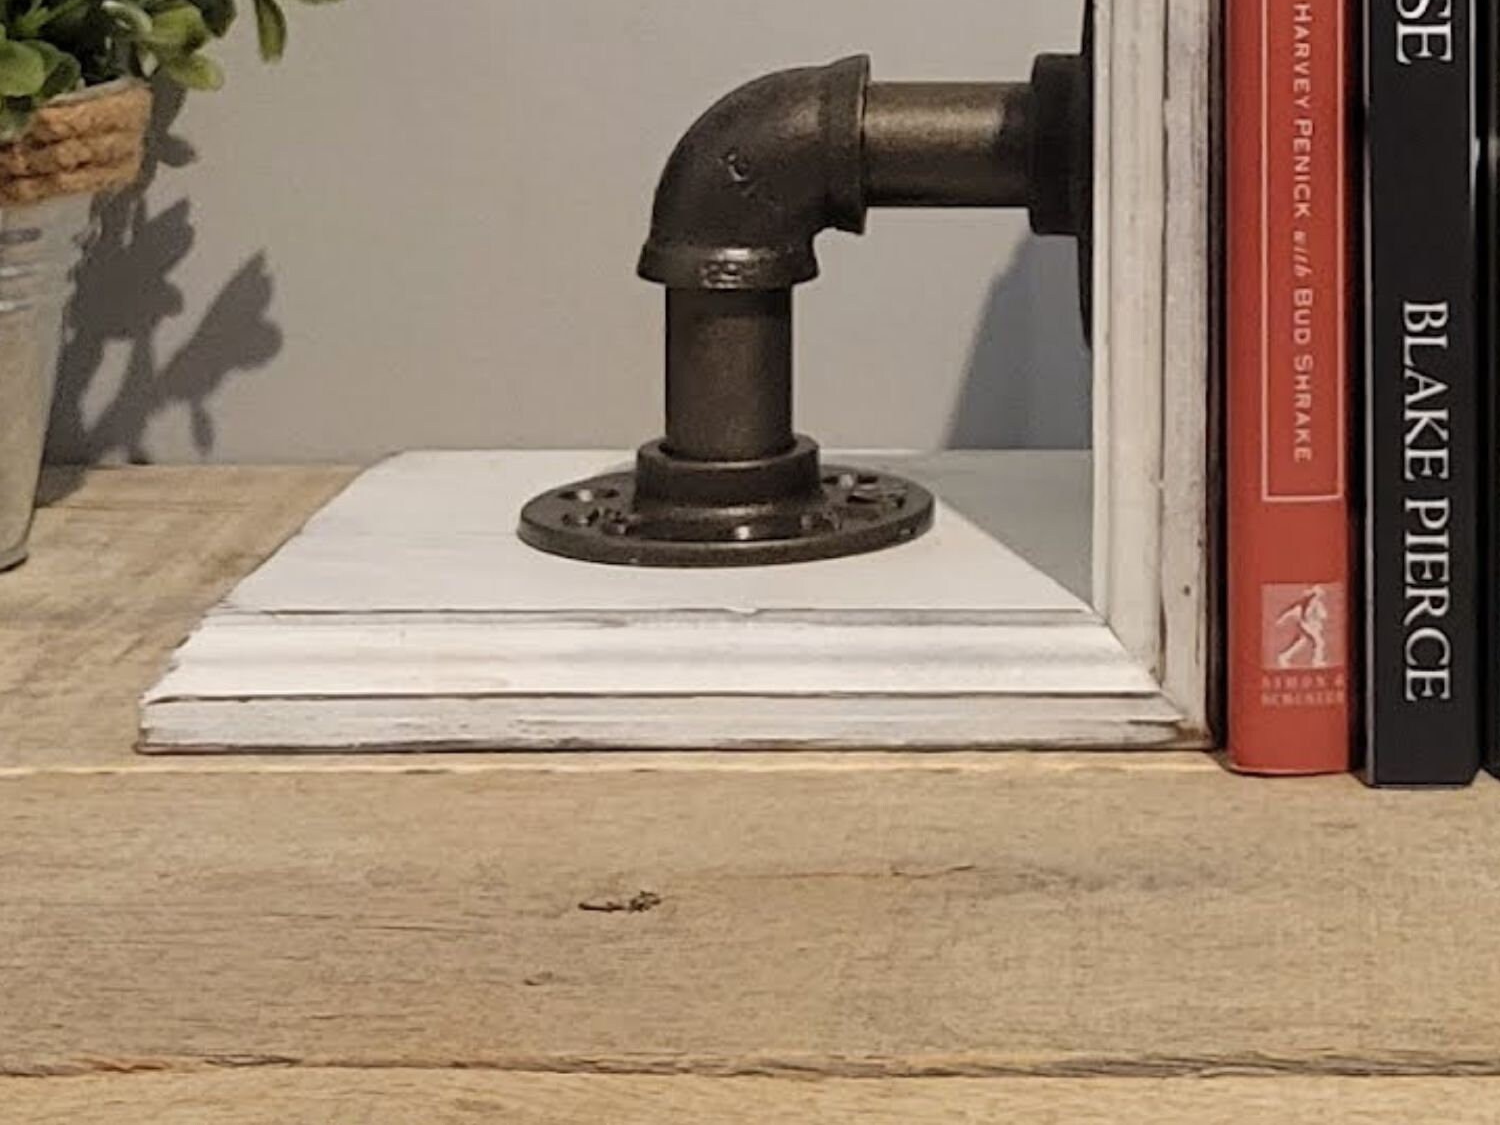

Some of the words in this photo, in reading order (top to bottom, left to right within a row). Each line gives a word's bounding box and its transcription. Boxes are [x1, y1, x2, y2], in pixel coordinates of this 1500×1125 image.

[1293, 2, 1312, 110] HARVEY
[1293, 119, 1313, 220] PENICK
[1293, 290, 1313, 345] BUD
[1293, 354, 1313, 463] SHRAKE
[1402, 300, 1450, 482] BLAKE
[1404, 497, 1453, 703] PIERCE
